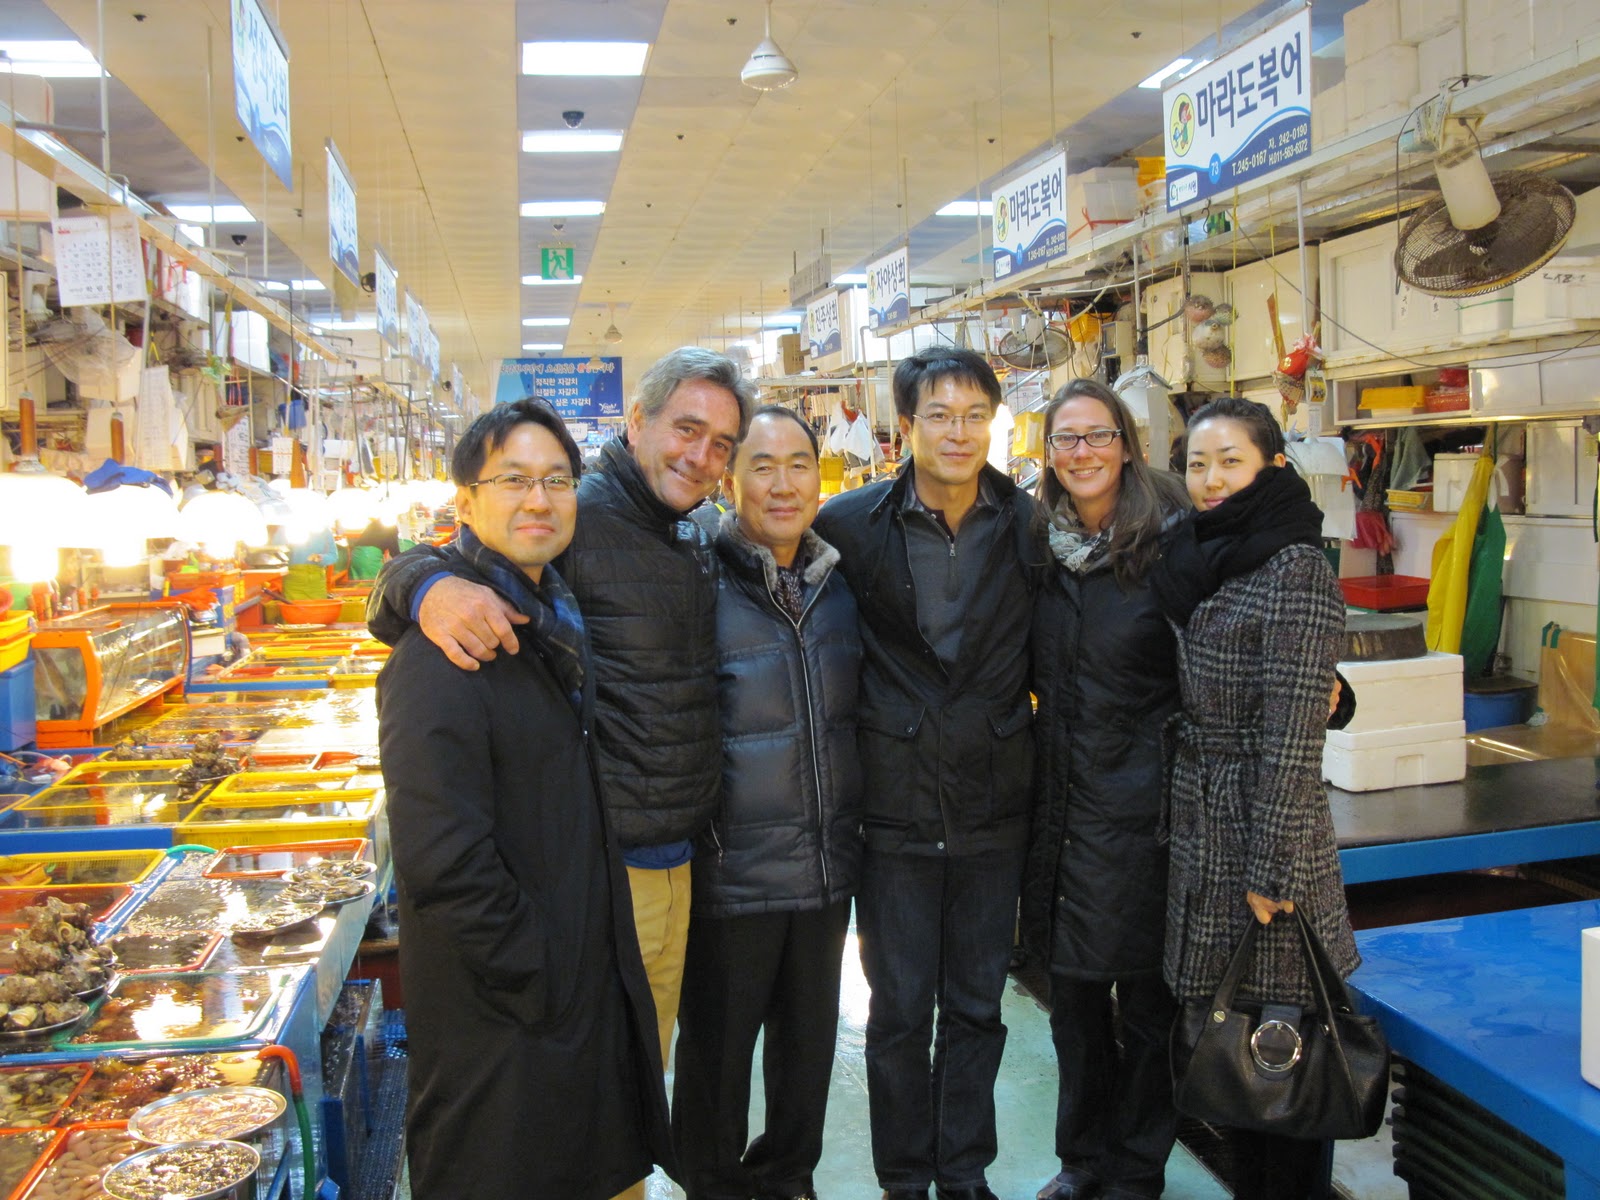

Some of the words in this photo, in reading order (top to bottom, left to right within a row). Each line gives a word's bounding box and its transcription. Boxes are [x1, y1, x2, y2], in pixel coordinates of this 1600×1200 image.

[1196, 31, 1302, 138] 마라도복어
[1279, 122, 1308, 147] 242-0190
[1211, 161, 1219, 176] 73
[1231, 149, 1267, 176] T.245-0167
[1009, 167, 1062, 231] 마라도복어
[877, 257, 906, 297] 자야상회
[815, 299, 837, 332] 진주상회
[536, 378, 556, 386] 정직한
[558, 378, 578, 386] 자갈치
[558, 388, 578, 396] 자갈치
[571, 398, 591, 407] 자갈치
